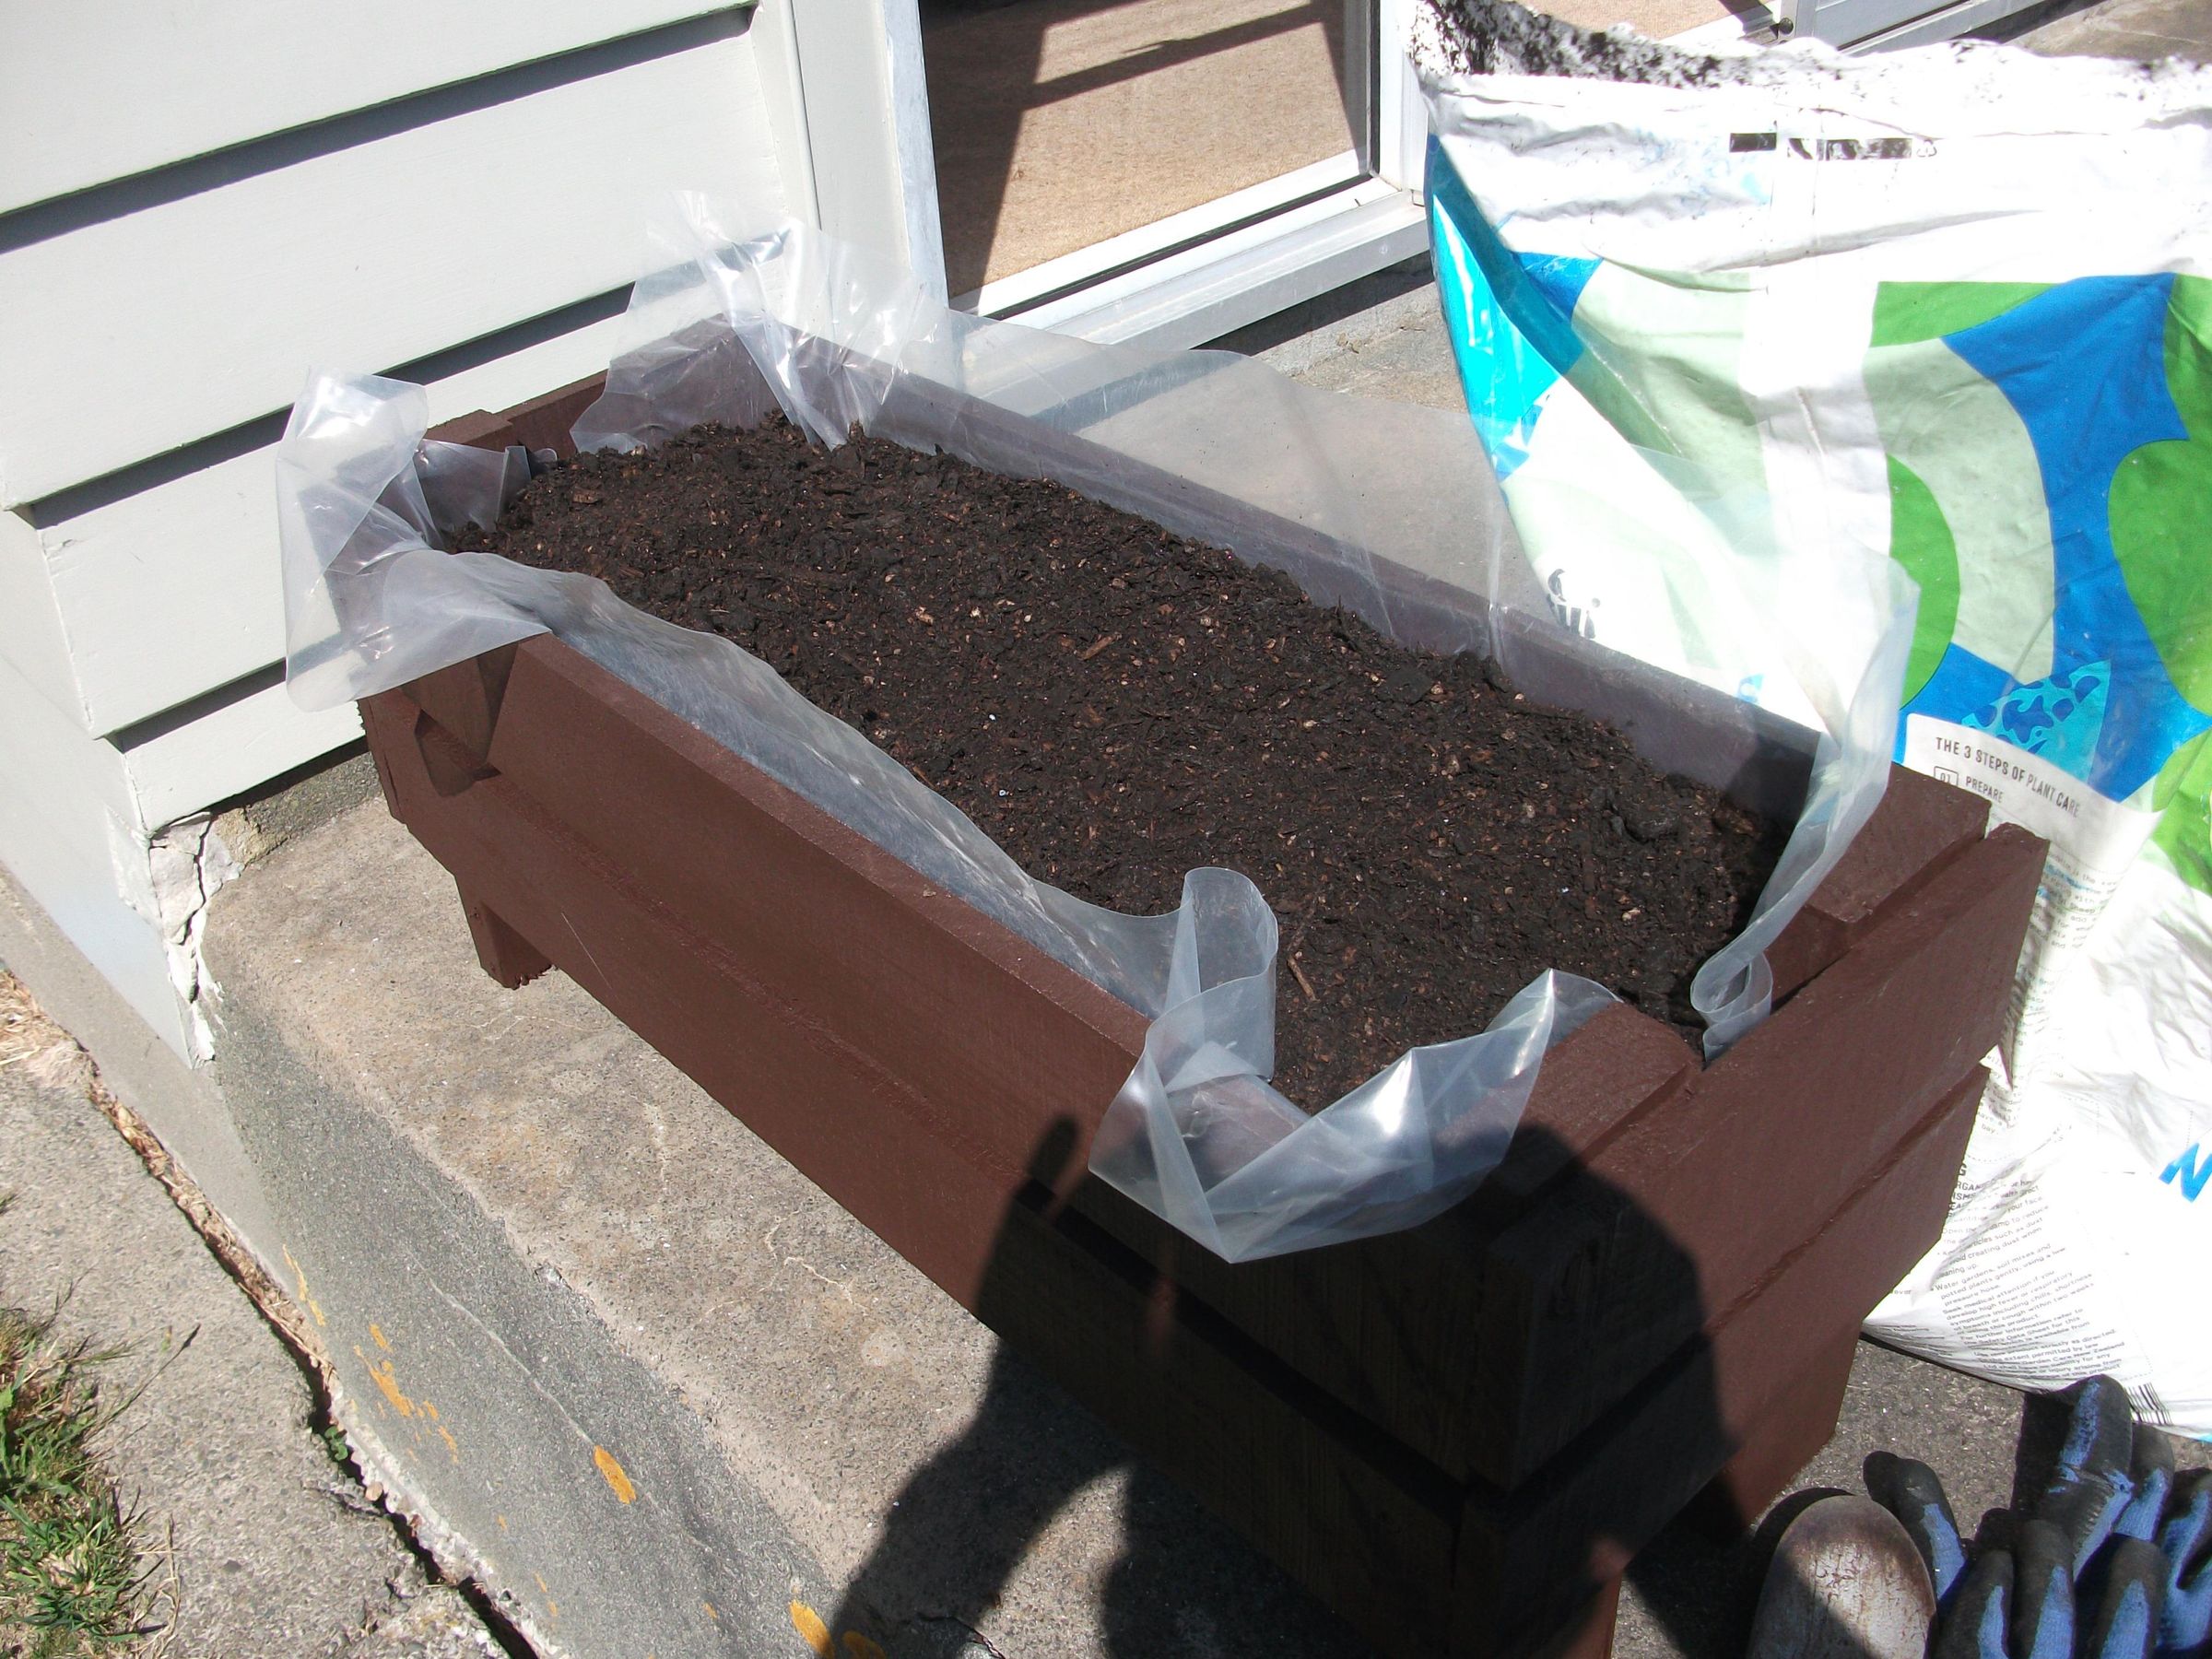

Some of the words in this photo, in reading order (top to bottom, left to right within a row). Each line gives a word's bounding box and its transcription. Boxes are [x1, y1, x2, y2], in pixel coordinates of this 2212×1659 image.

[1936, 736, 1959, 756] THE
[1964, 746, 1971, 759] 3
[1975, 749, 2008, 775] STEPS
[2012, 766, 2026, 782] OF
[2027, 773, 2055, 801] PLANT
[2056, 792, 2081, 818] CARE
[1966, 776, 2005, 804] PREPARE
[1967, 1244, 2001, 1260] creating
[2002, 1237, 2019, 1248] dust
[1935, 1281, 1959, 1291] Water
[1940, 1286, 1967, 1300] potted
[1969, 1277, 1994, 1290] plants
[1964, 1296, 1994, 1309] medical
[1996, 1281, 2032, 1298] attention
[1947, 1308, 1978, 1321] develop
[1979, 1301, 1997, 1312] high
[1949, 1313, 1991, 1326] symptoms
[1993, 1300, 2030, 1316] including
[2006, 1318, 2052, 1333] information
[2031, 1347, 2071, 1359] permitted
